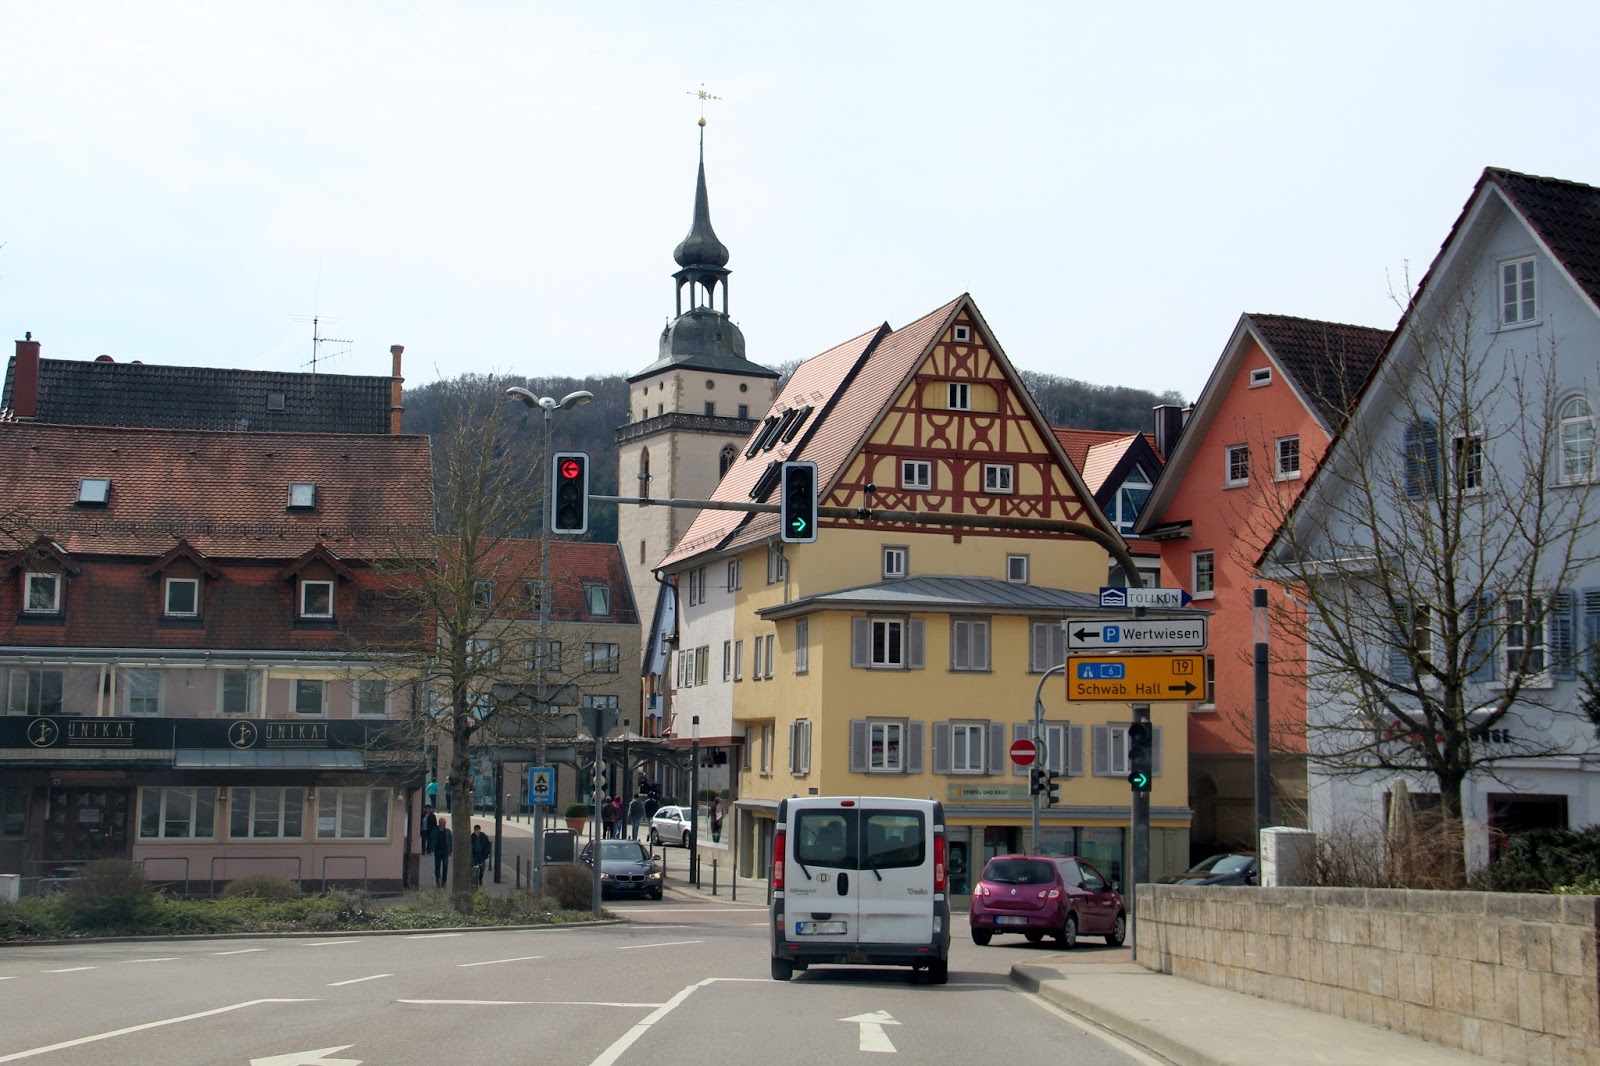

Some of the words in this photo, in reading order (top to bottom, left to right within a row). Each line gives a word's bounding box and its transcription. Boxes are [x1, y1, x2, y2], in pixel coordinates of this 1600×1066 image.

[1128, 592, 1179, 604] TOLLKÜN
[1106, 628, 1116, 641] P
[1122, 627, 1200, 641] Wertwiesen
[1175, 661, 1189, 673] 19
[1077, 683, 1130, 695] Schwäb.
[1135, 683, 1161, 695] Hall
[68, 723, 134, 737] UNIKAT
[265, 724, 328, 739] UNIKAT
